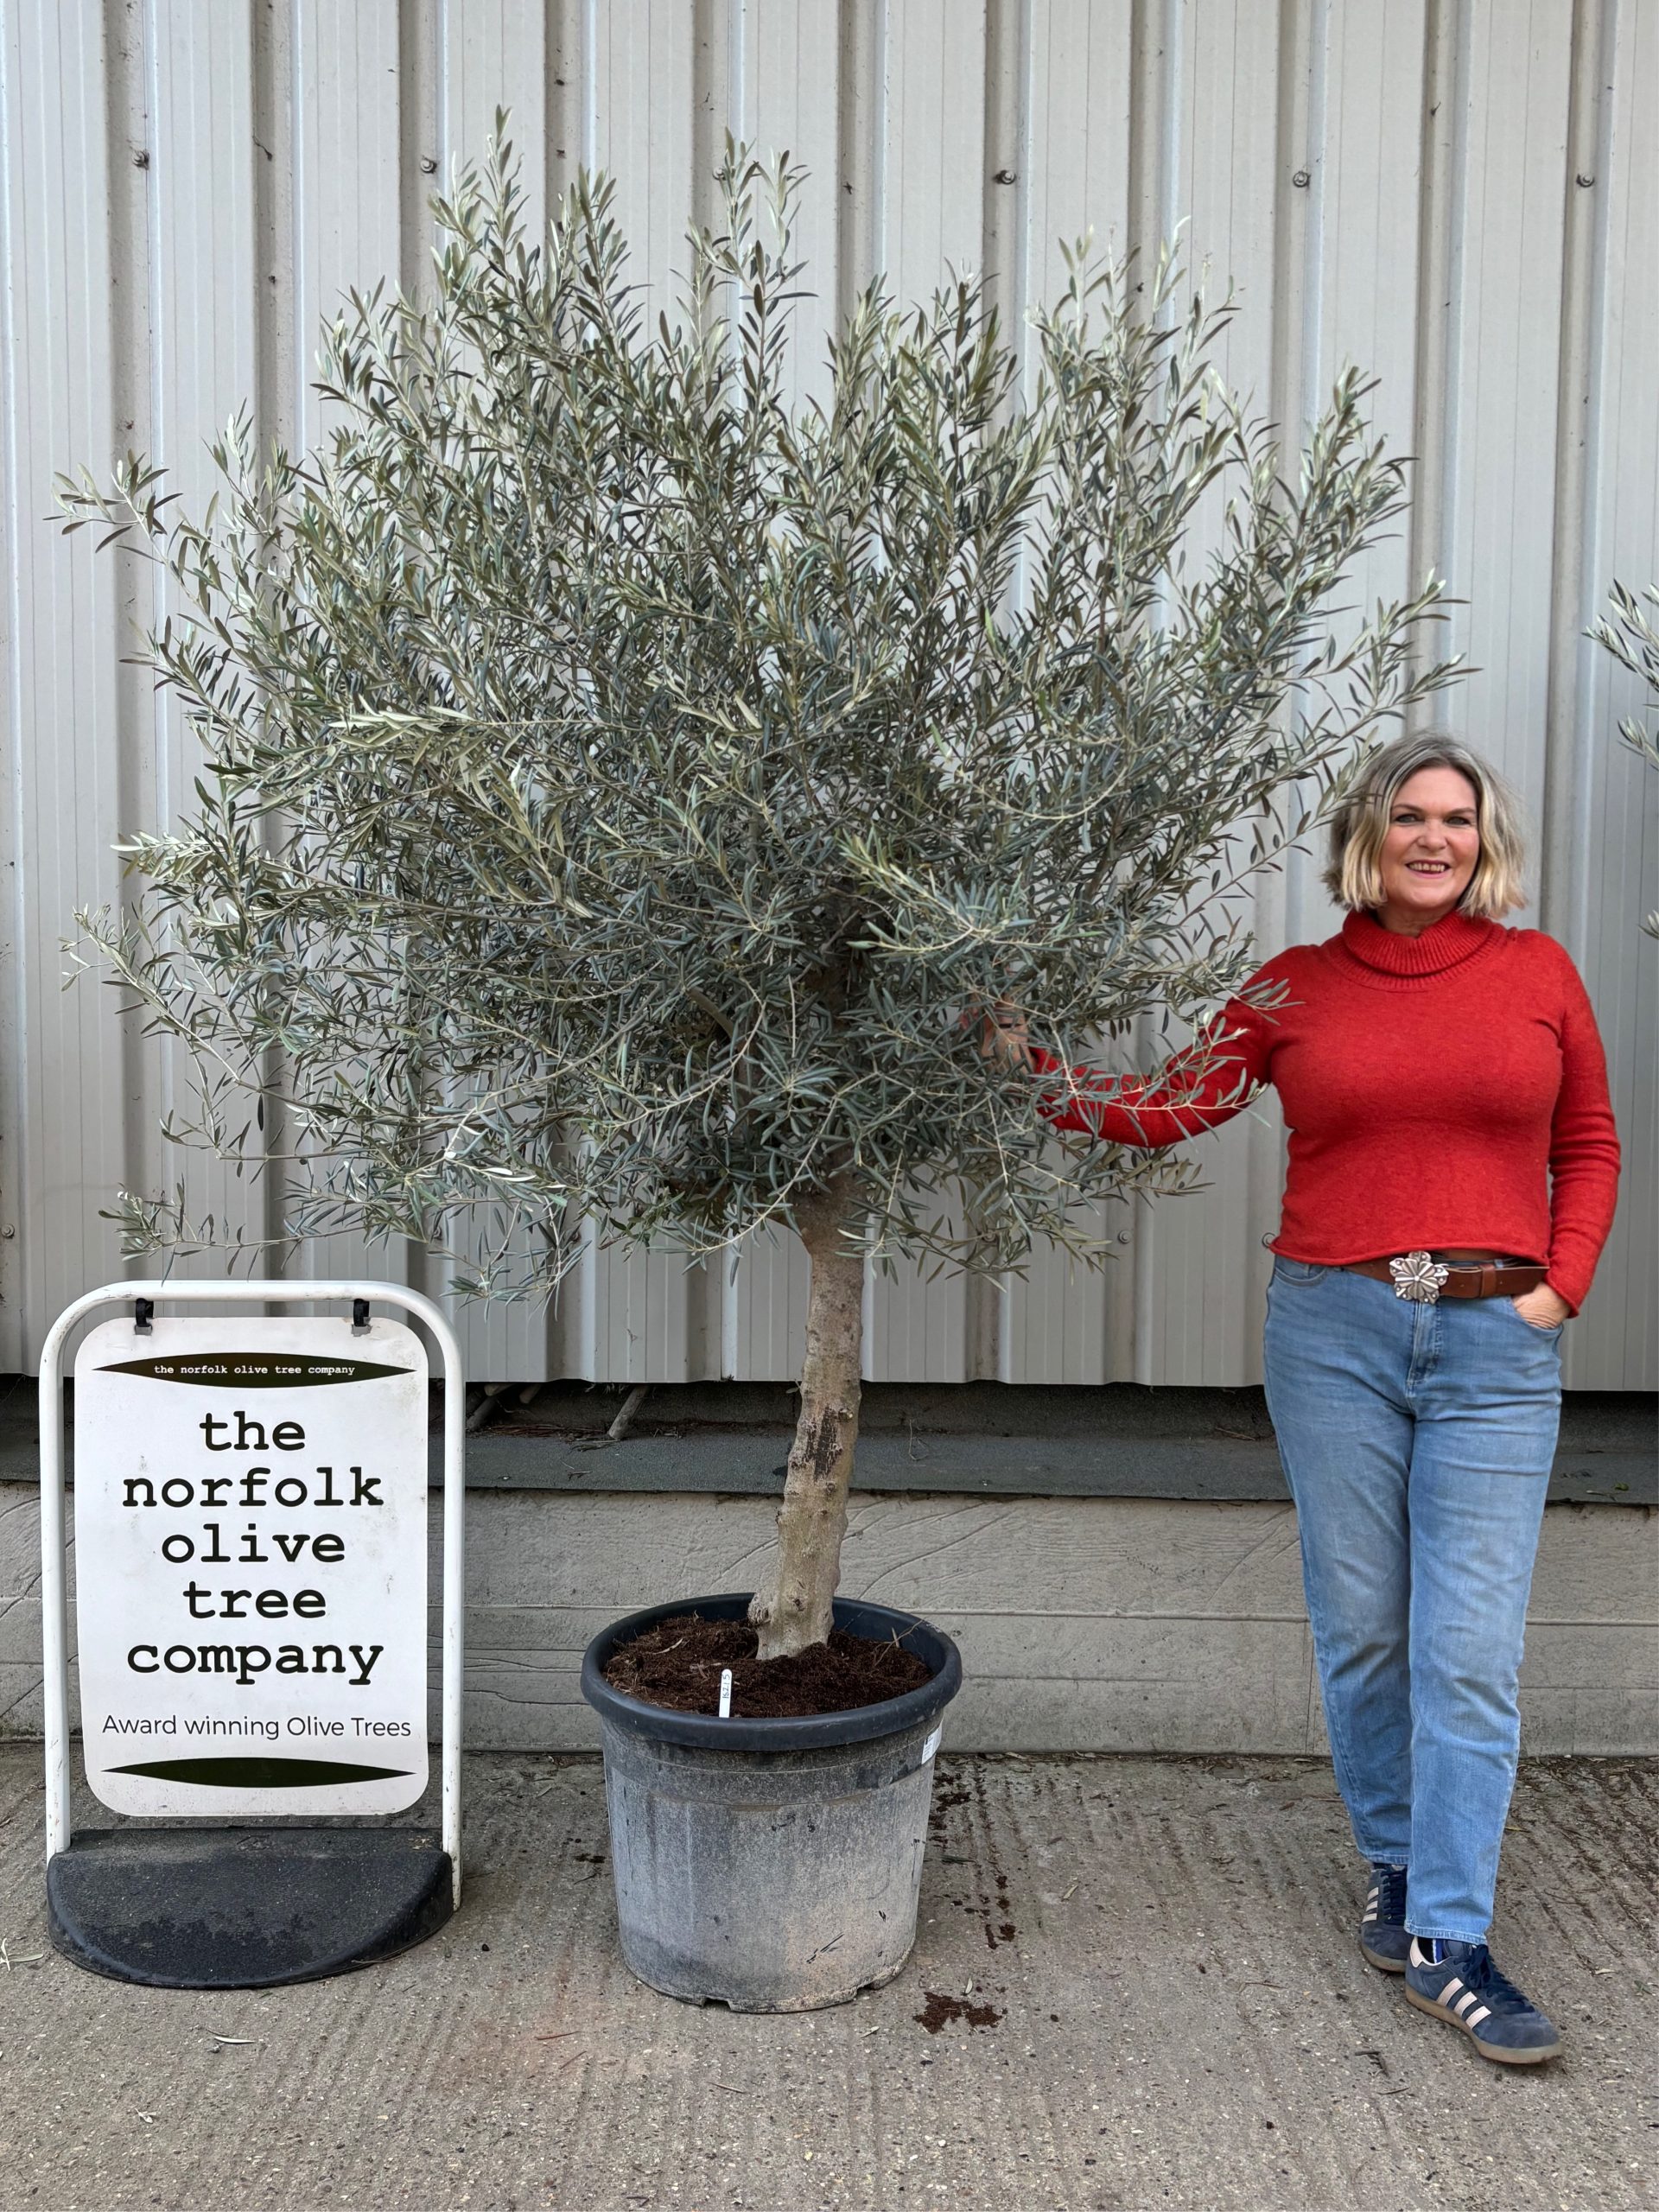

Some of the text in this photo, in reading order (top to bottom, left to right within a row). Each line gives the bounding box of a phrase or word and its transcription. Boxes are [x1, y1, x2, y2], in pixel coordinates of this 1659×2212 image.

[154, 1364, 356, 1376] the norfolk olive tree company
[199, 1410, 306, 1452] the
[122, 1466, 385, 1508] norfolk
[162, 1522, 345, 1564] olive
[182, 1580, 327, 1619] tree
[127, 1643, 385, 1686] company
[102, 1714, 411, 1741] Award winning Olive Trees
